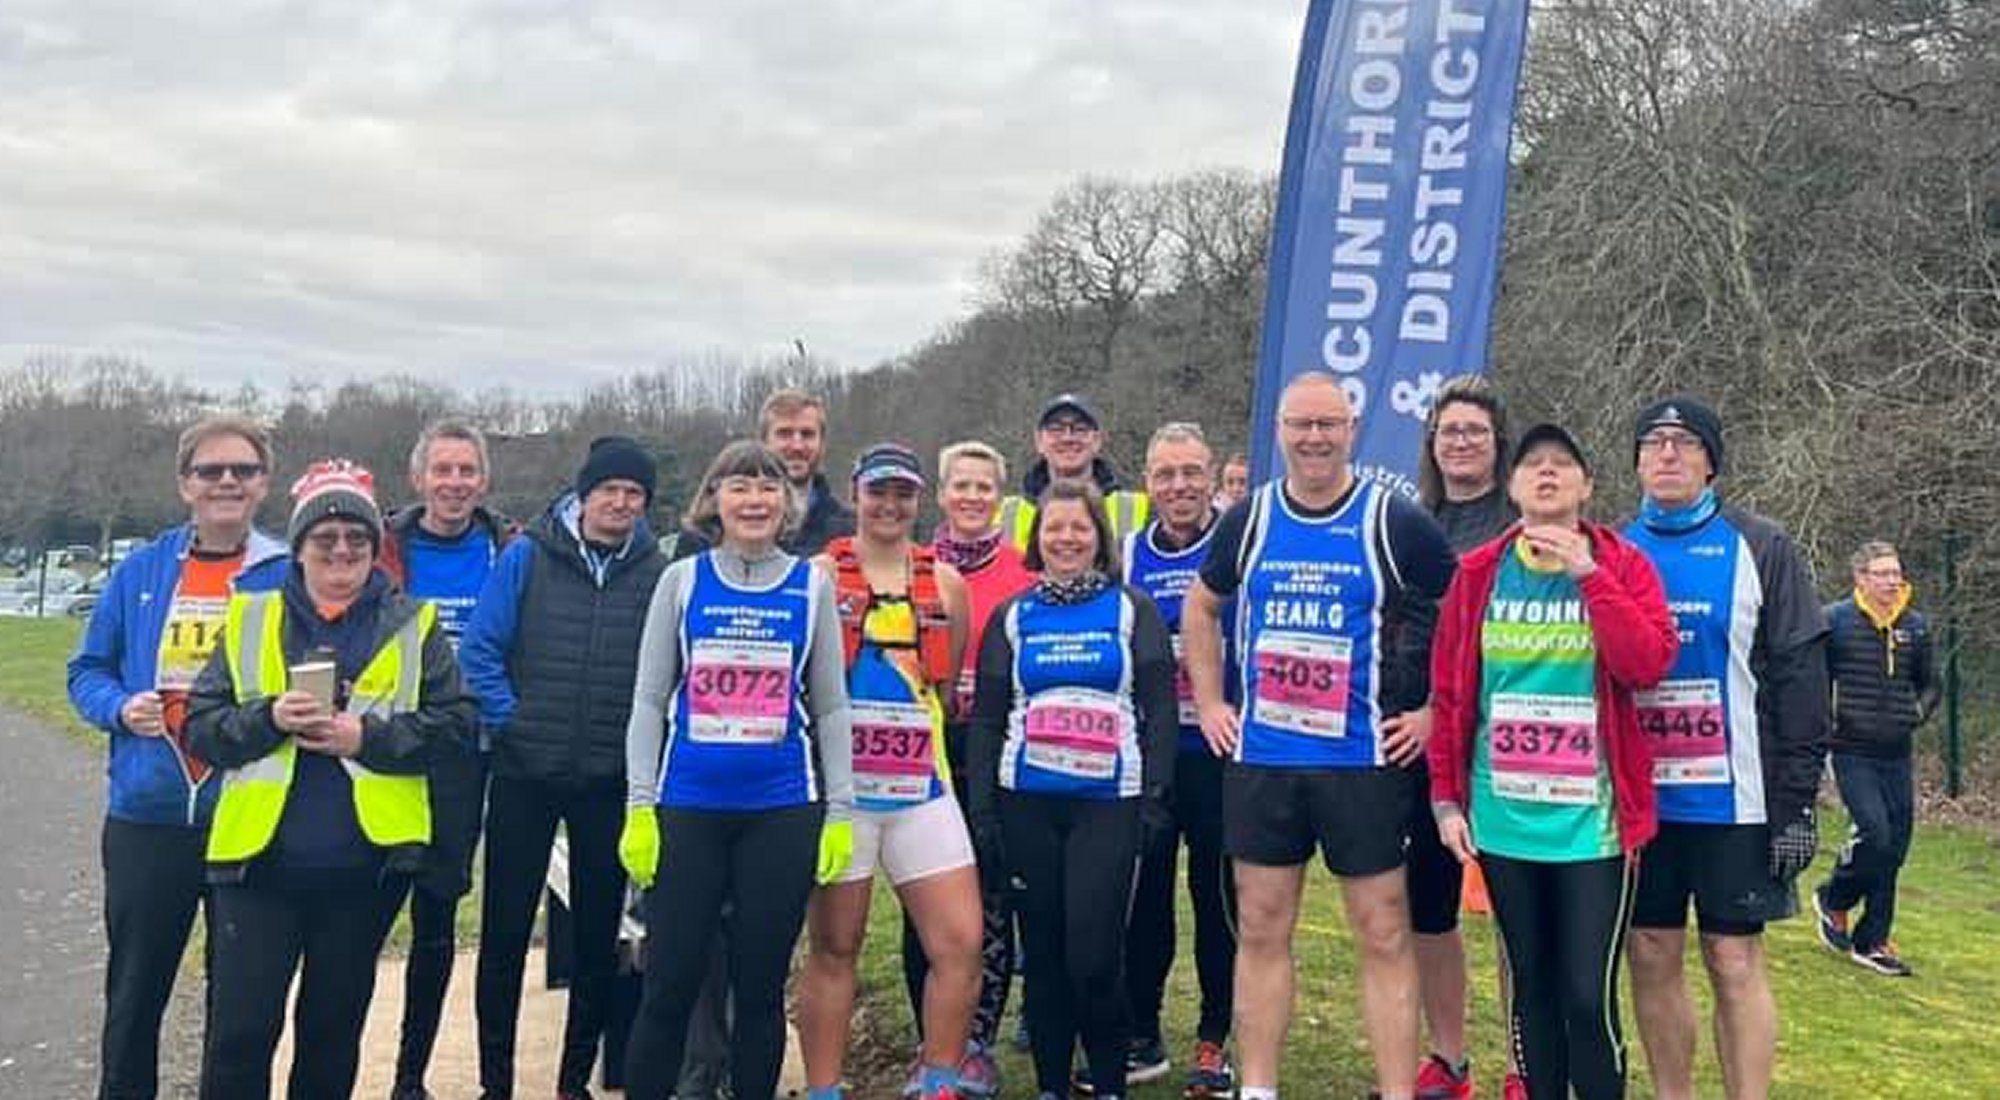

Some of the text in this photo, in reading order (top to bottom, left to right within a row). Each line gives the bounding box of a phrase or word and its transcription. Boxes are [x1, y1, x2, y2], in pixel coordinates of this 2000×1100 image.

[1323, 0, 1407, 417] CUNTHOR
[1391, 0, 1484, 421] & DISTRICT
[1494, 600, 1590, 622] YVONN
[693, 667, 785, 698] 3072
[1033, 707, 1115, 736] 1504
[851, 726, 931, 758] 3537
[1494, 723, 1593, 756] 3374
